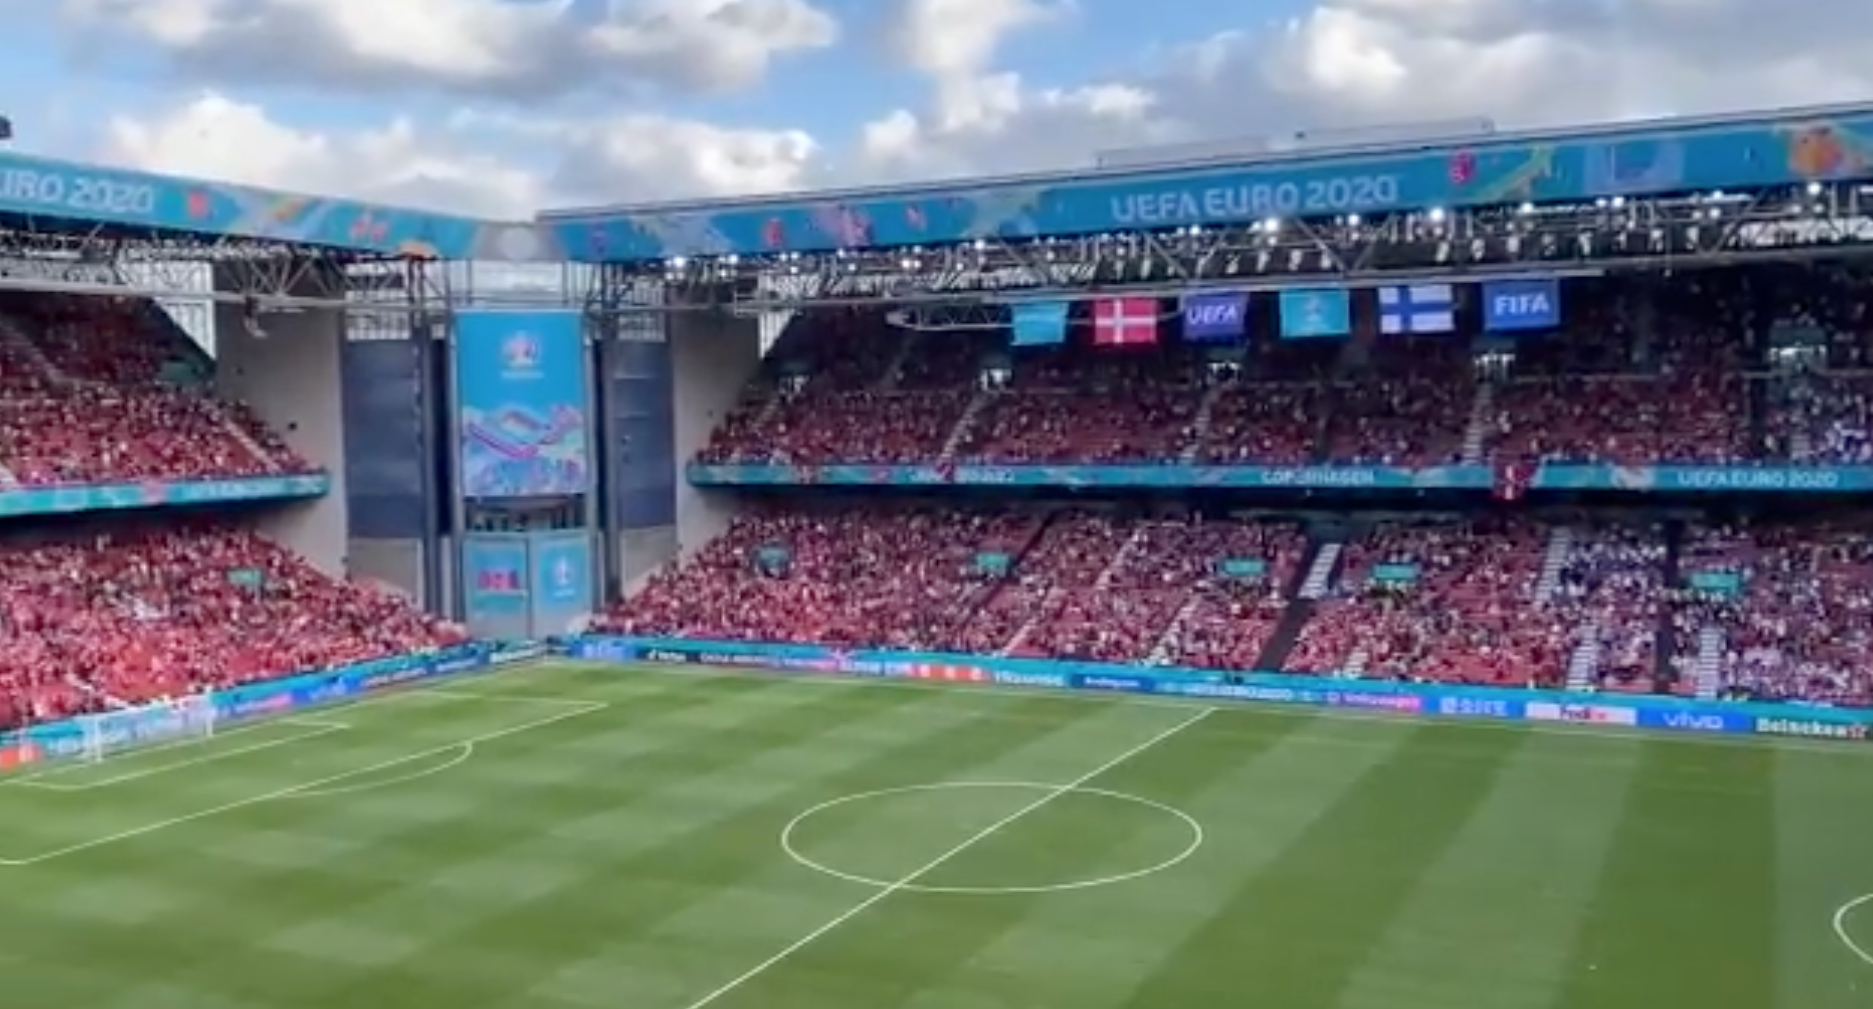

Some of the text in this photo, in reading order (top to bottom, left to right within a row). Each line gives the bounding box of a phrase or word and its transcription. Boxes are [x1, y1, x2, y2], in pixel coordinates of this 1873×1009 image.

[68, 180, 154, 213] 2020
[1111, 174, 1398, 222] UEFA EURO 2020
[1494, 293, 1549, 316] FIFA
[1187, 305, 1236, 327] UEFA
[1677, 470, 1727, 486] UEFA
[1788, 471, 1839, 488] 2020
[1662, 713, 1724, 729] vivo
